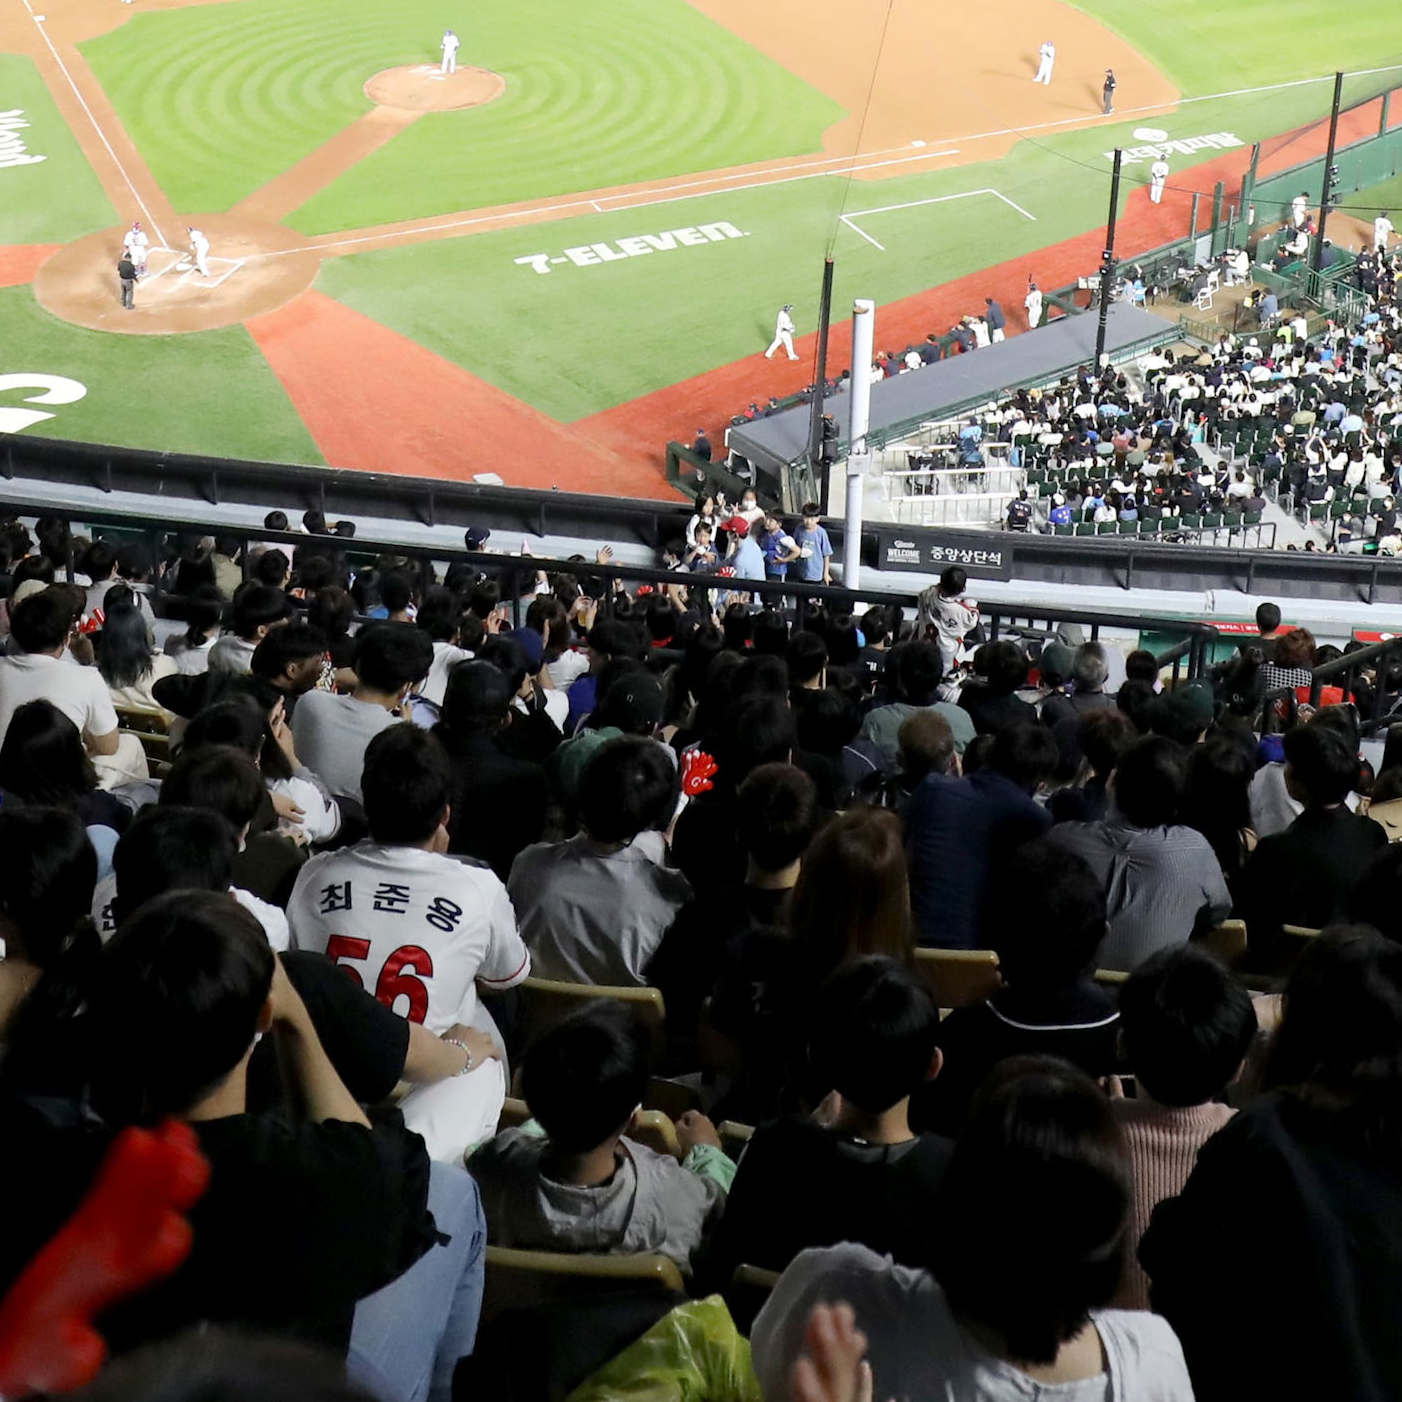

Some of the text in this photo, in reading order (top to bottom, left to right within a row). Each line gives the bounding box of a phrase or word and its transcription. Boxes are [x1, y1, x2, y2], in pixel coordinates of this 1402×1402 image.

[887, 548, 920, 558] WELCOME
[930, 546, 1002, 566] 중앙상단석
[321, 881, 463, 932] 최준용
[326, 934, 434, 1025] 56
